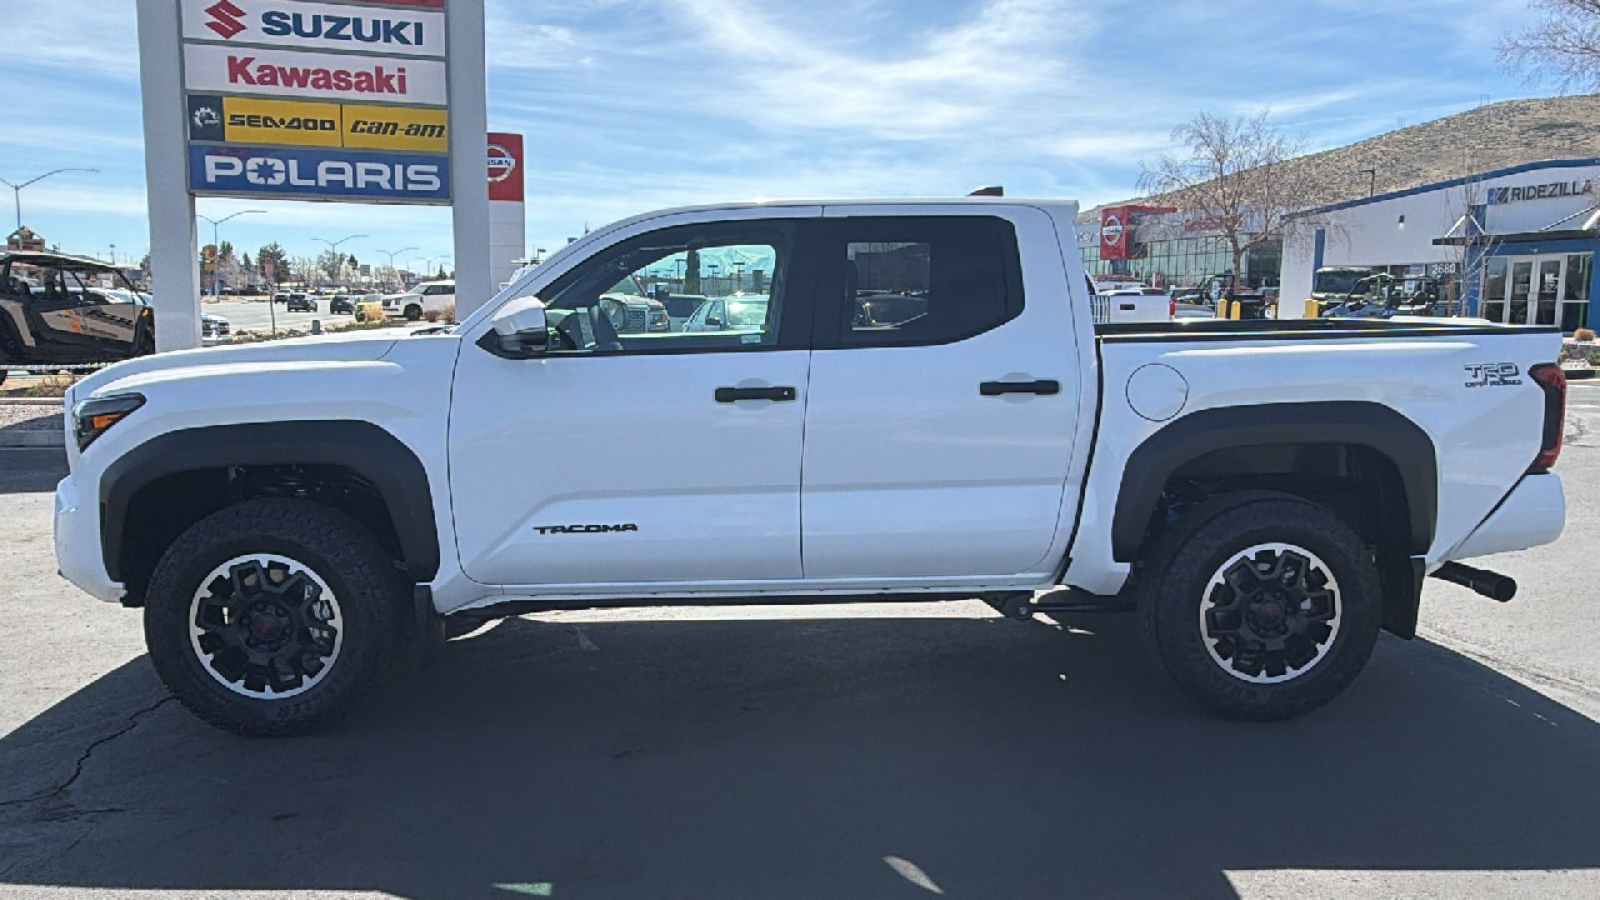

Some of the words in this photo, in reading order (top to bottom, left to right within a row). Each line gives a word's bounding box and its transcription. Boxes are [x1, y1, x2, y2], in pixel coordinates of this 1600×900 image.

[261, 11, 424, 46] SUZUKI
[227, 55, 407, 94] Kawasaki
[350, 119, 446, 138] can-am
[204, 155, 441, 191] POLARIS
[1511, 180, 1592, 201] RIDEZILLA
[1463, 362, 1520, 382] TRD
[532, 523, 638, 535] TACOMA
